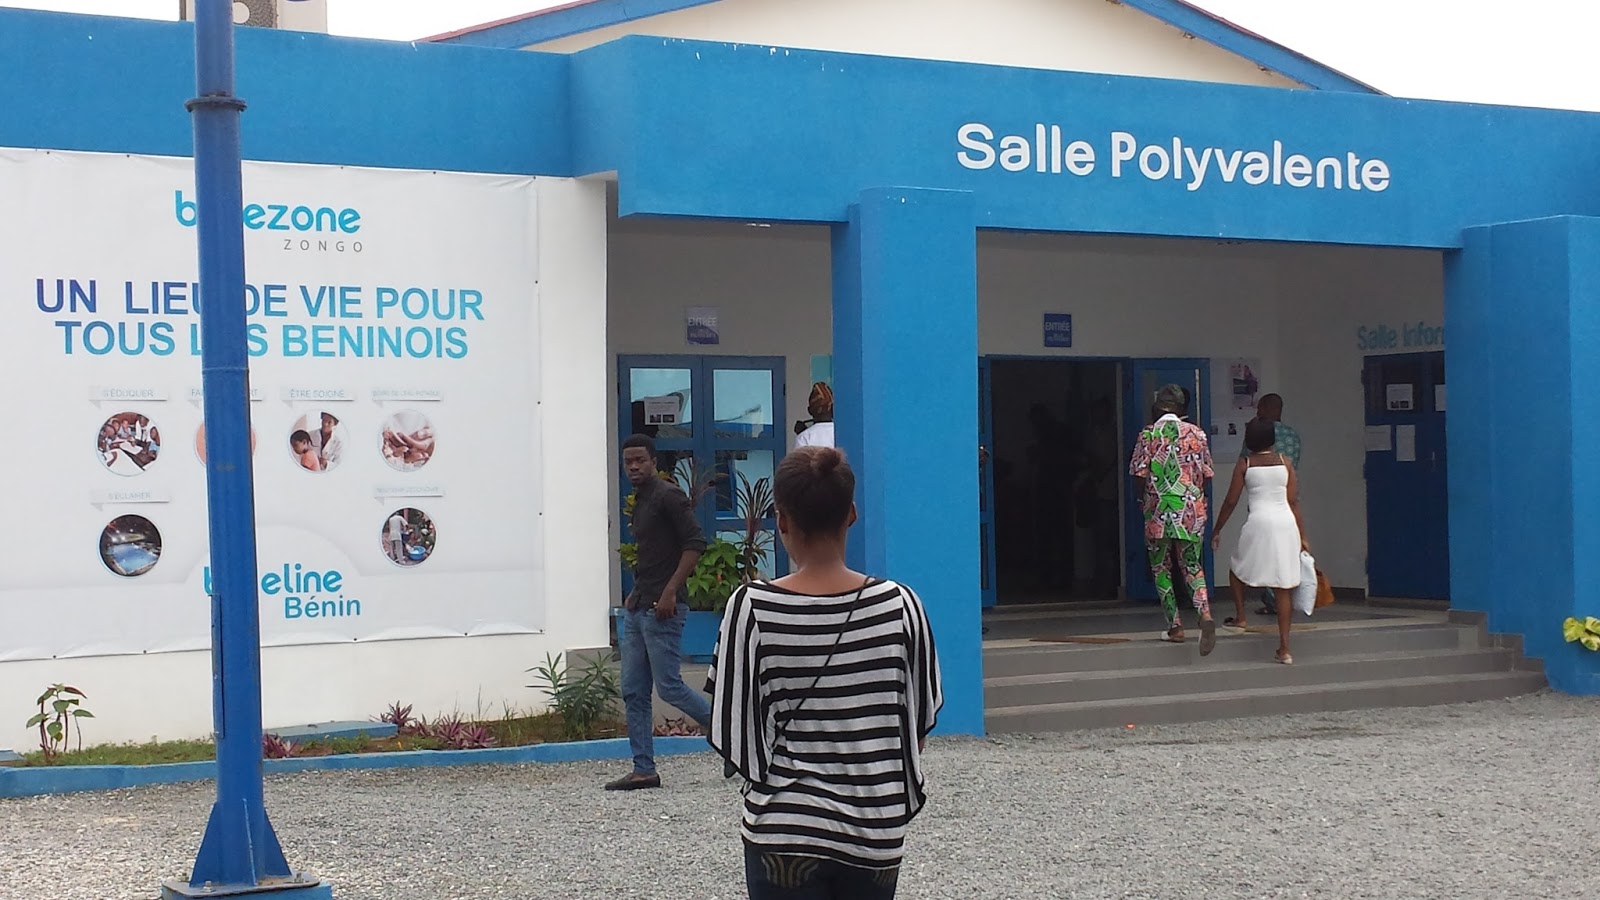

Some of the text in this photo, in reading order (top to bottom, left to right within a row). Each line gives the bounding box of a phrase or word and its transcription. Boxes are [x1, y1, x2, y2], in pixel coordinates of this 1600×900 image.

[956, 123, 1391, 192] Salle Polyvalente
[174, 190, 361, 234] bezone
[283, 238, 364, 253] ZONGO
[36, 279, 97, 314] UN
[299, 284, 363, 319] VIE
[376, 287, 485, 321] POUR
[55, 320, 470, 360] TOUS LS BENINOIS
[1358, 320, 1446, 350] Salle Infor
[285, 595, 361, 619] Bénin
